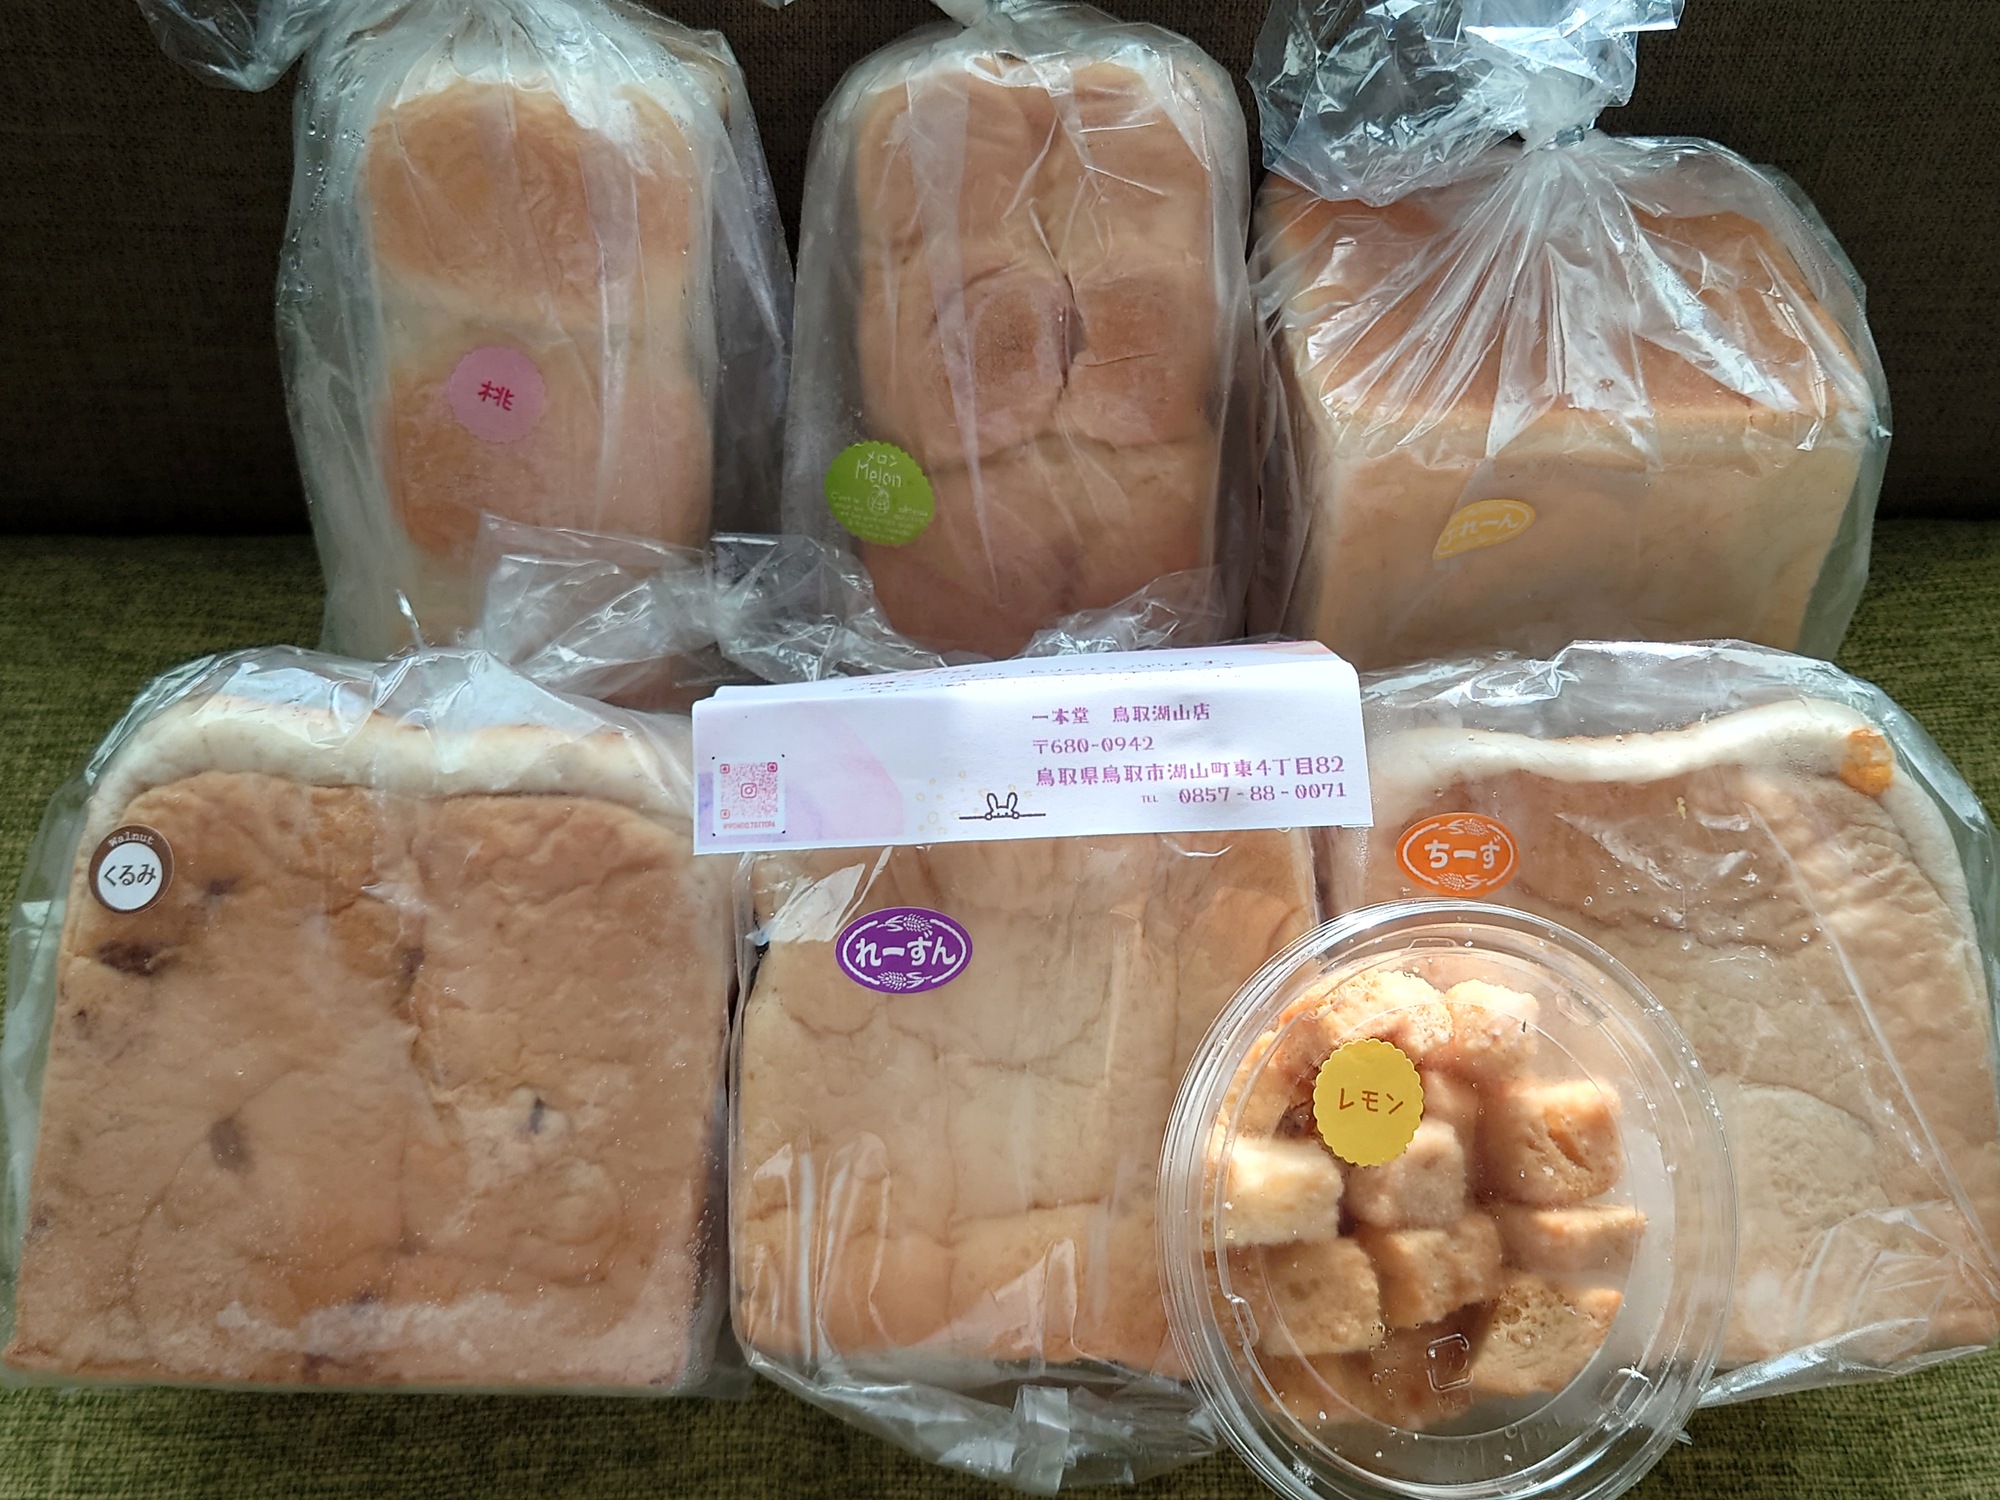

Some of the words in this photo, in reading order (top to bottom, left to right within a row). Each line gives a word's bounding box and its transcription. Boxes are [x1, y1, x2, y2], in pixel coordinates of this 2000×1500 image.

[477, 380, 515, 412] 桃
[866, 450, 898, 467] メロン
[855, 459, 902, 488] Melon
[1031, 706, 1090, 725] 一本堂
[1111, 702, 1211, 724] 鳥取湖山店
[1035, 755, 1346, 788] 鳥取県鳥取市湖山町東4丁目82
[108, 830, 155, 847] Walnut
[1424, 835, 1501, 869] ちーず
[103, 863, 157, 888] くるみ
[855, 930, 957, 968] れーずん
[1338, 1087, 1404, 1115] レモン
